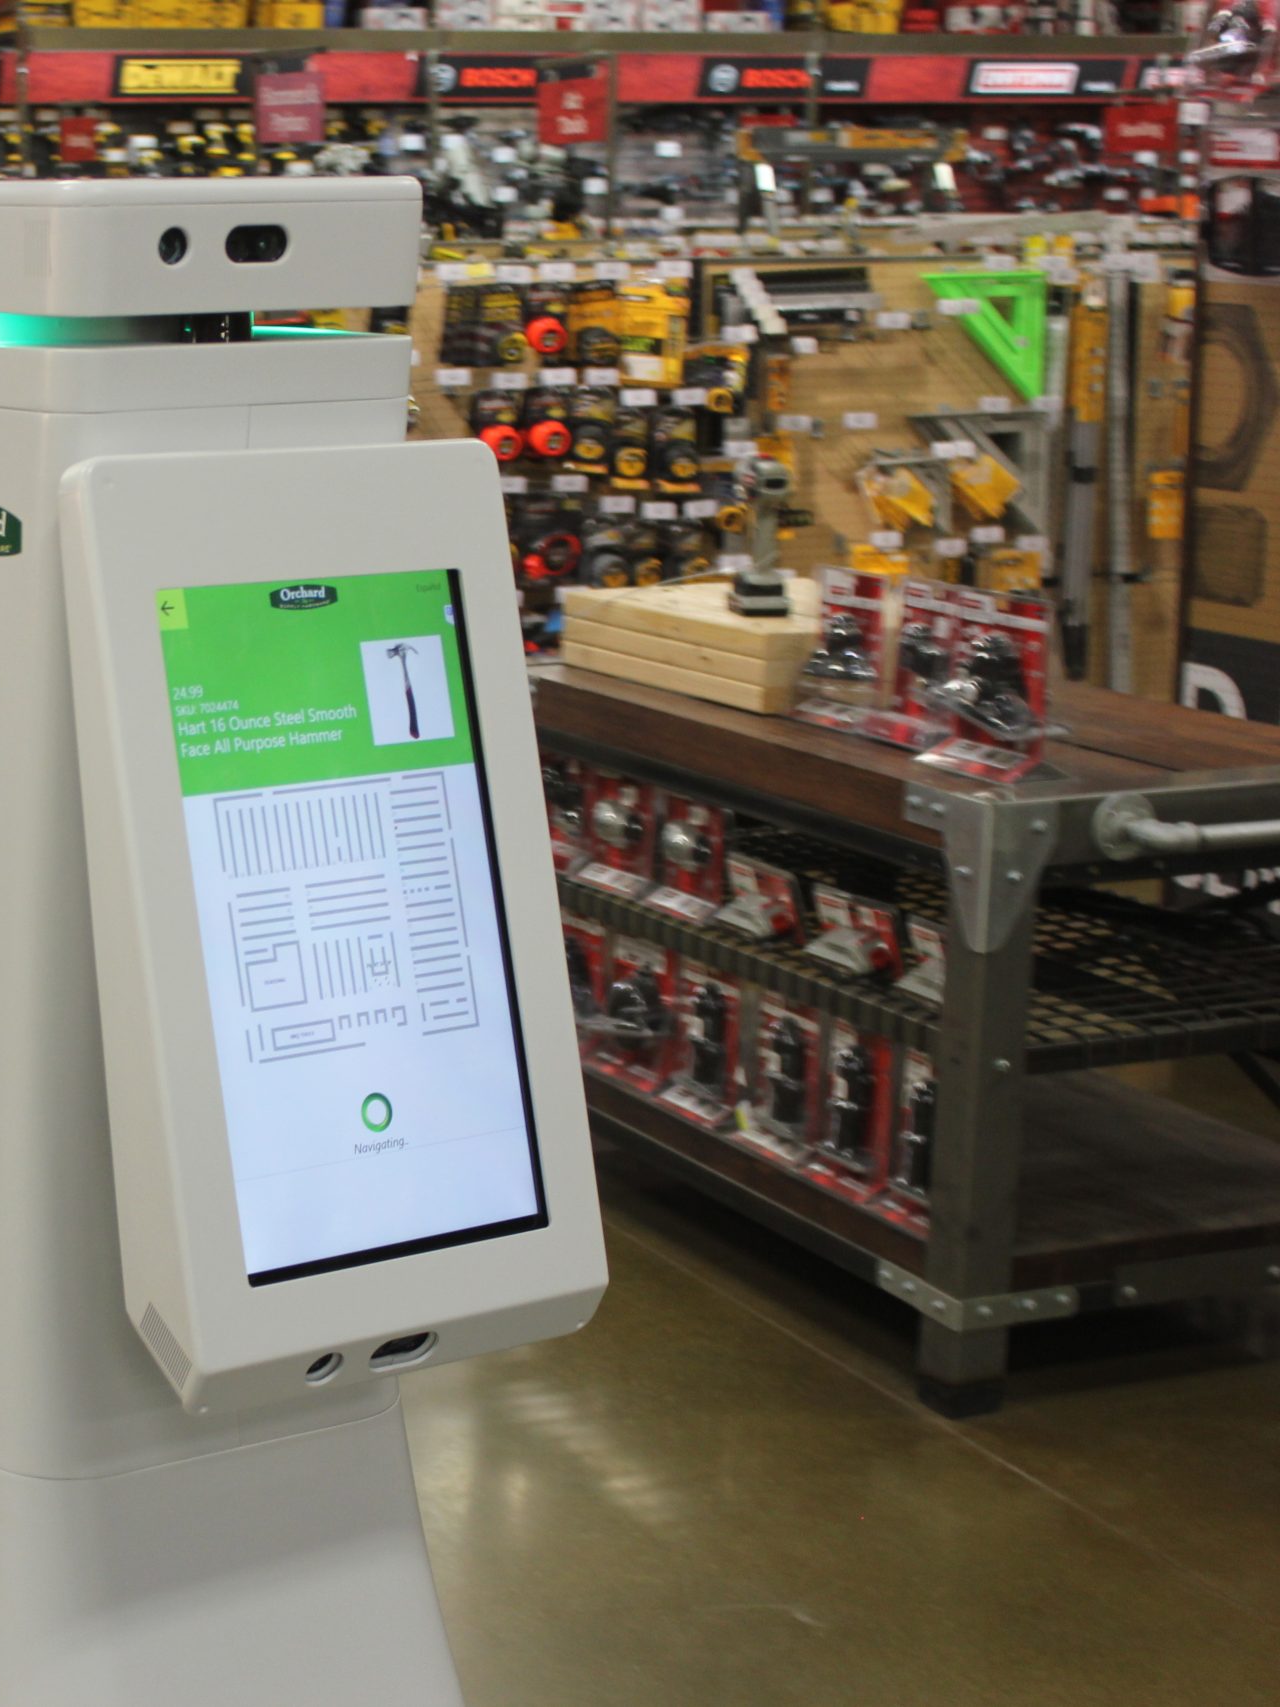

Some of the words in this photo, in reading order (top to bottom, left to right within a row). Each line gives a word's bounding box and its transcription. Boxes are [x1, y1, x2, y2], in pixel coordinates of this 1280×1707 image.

[280, 585, 326, 602] Orchard
[178, 721, 207, 737] Hart
[210, 718, 226, 733] 16
[229, 715, 270, 731] Ounce
[273, 709, 305, 727] Steel
[308, 704, 357, 723] Smooth
[180, 743, 210, 758] Face
[214, 739, 231, 755] All
[234, 734, 286, 754] Purpose
[289, 728, 343, 746] Hammer
